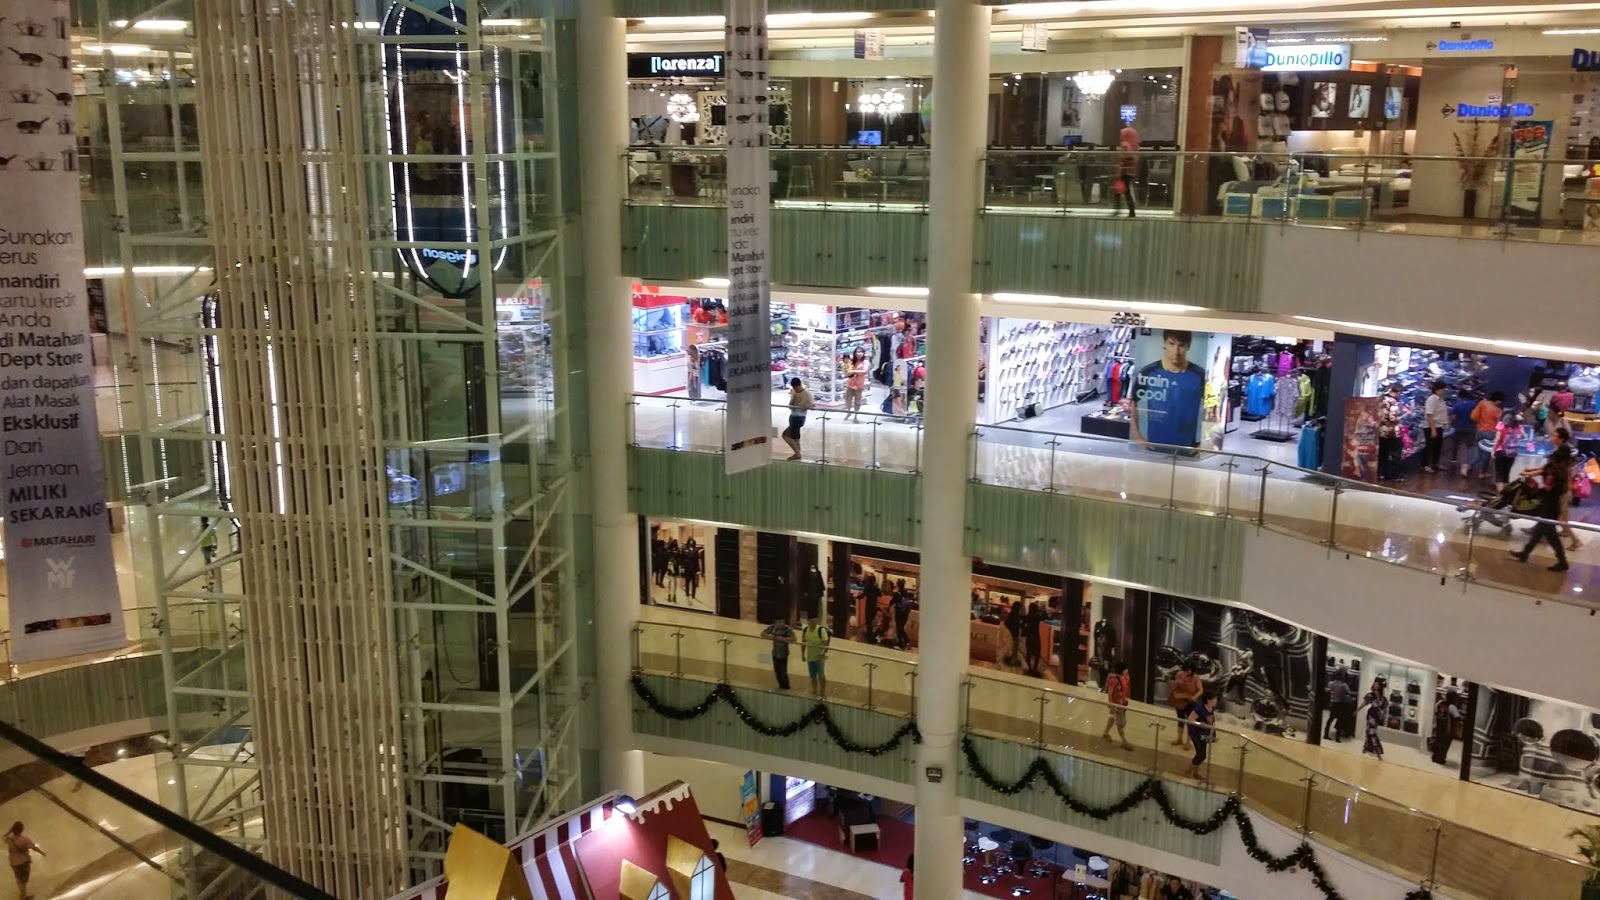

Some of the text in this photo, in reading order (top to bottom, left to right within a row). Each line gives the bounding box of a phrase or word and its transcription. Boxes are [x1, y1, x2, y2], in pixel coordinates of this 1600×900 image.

[0, 228, 73, 245] Gunakan
[0, 295, 37, 308] artu
[0, 311, 51, 328] Anda
[0, 331, 84, 348] di Matahari
[0, 352, 83, 370] Dept Store
[1, 376, 29, 390] dan
[1137, 373, 1169, 388] train
[3, 394, 80, 409] Alat Masak
[1136, 389, 1166, 402] cool
[3, 413, 80, 432] Eksklusif
[4, 438, 43, 456] Dari
[7, 463, 79, 479] Jerman
[9, 484, 68, 504] MILIKI
[10, 502, 103, 524] SEKARANG
[33, 534, 96, 546] MATAHARI
